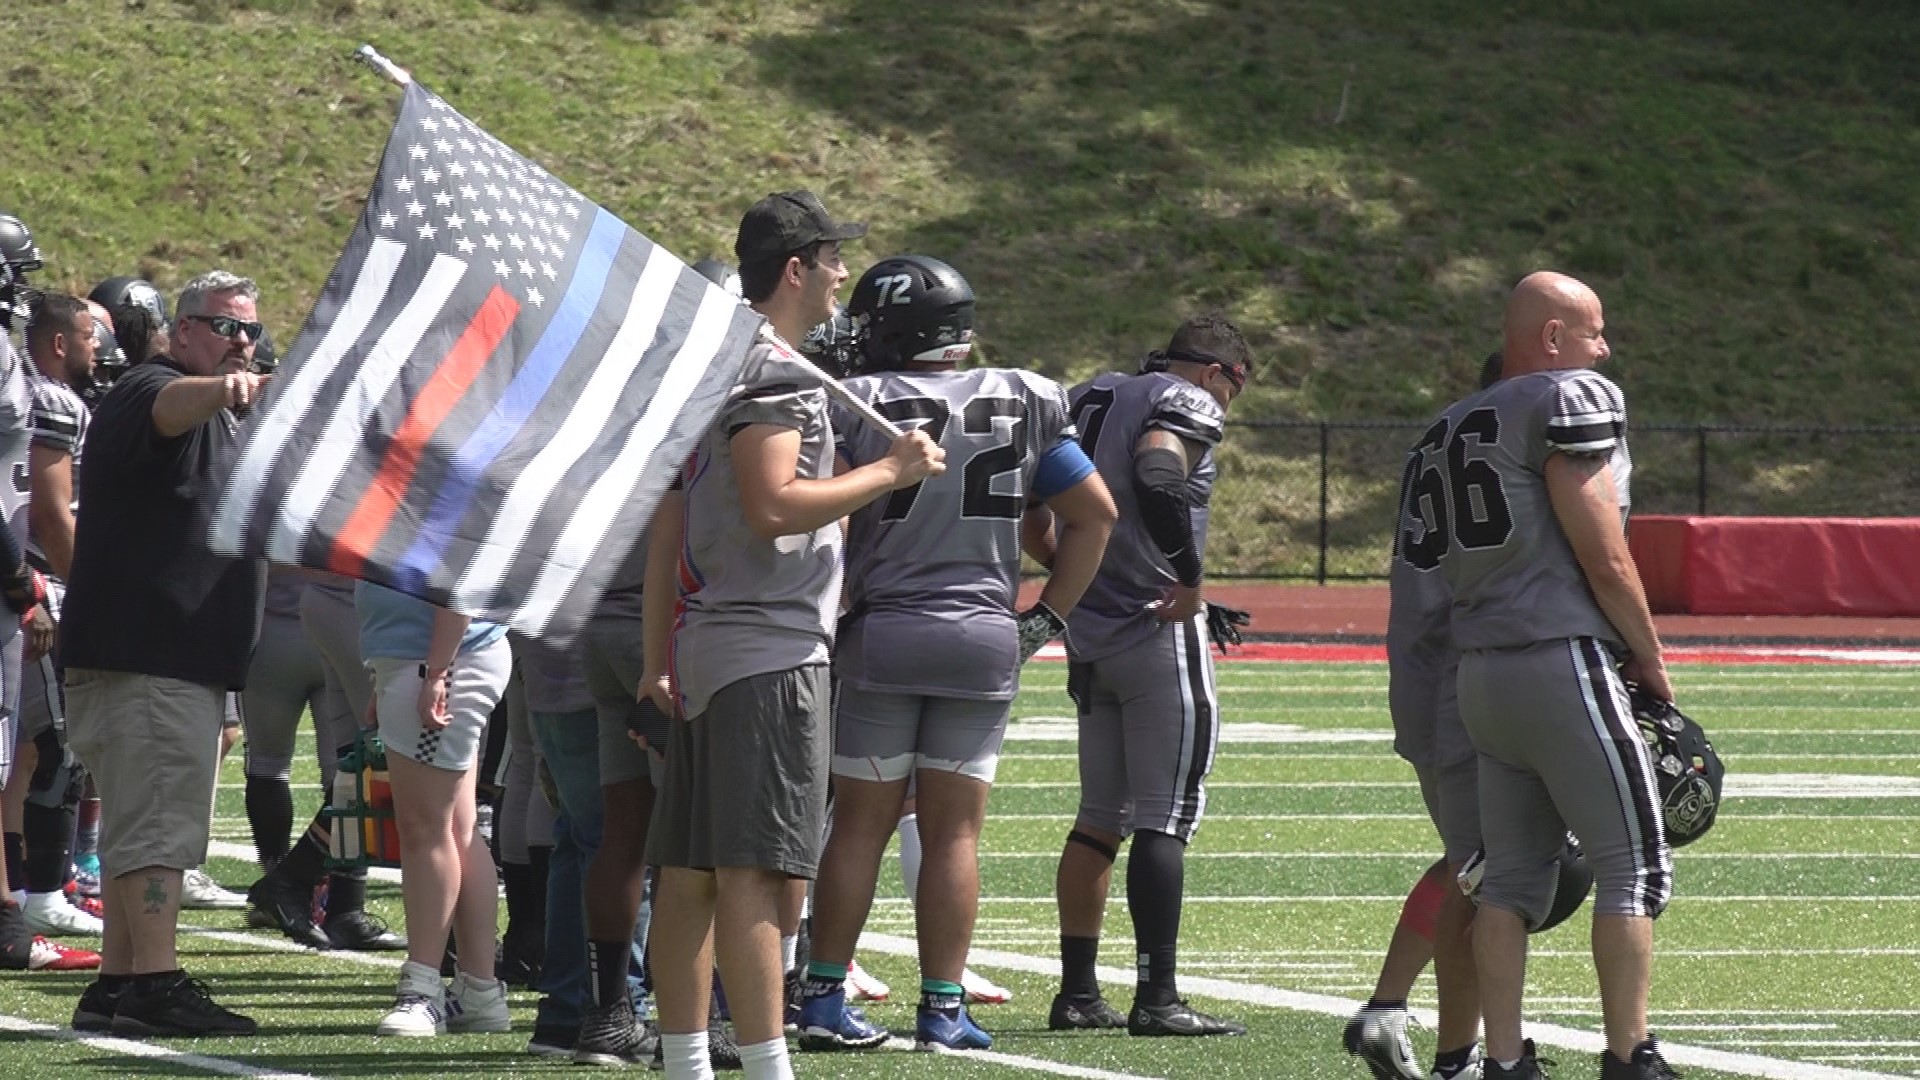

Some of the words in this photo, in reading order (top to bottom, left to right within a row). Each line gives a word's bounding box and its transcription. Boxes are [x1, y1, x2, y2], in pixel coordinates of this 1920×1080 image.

[874, 273, 912, 308] 72
[872, 396, 1030, 525] 72
[1409, 406, 1516, 556] 66
